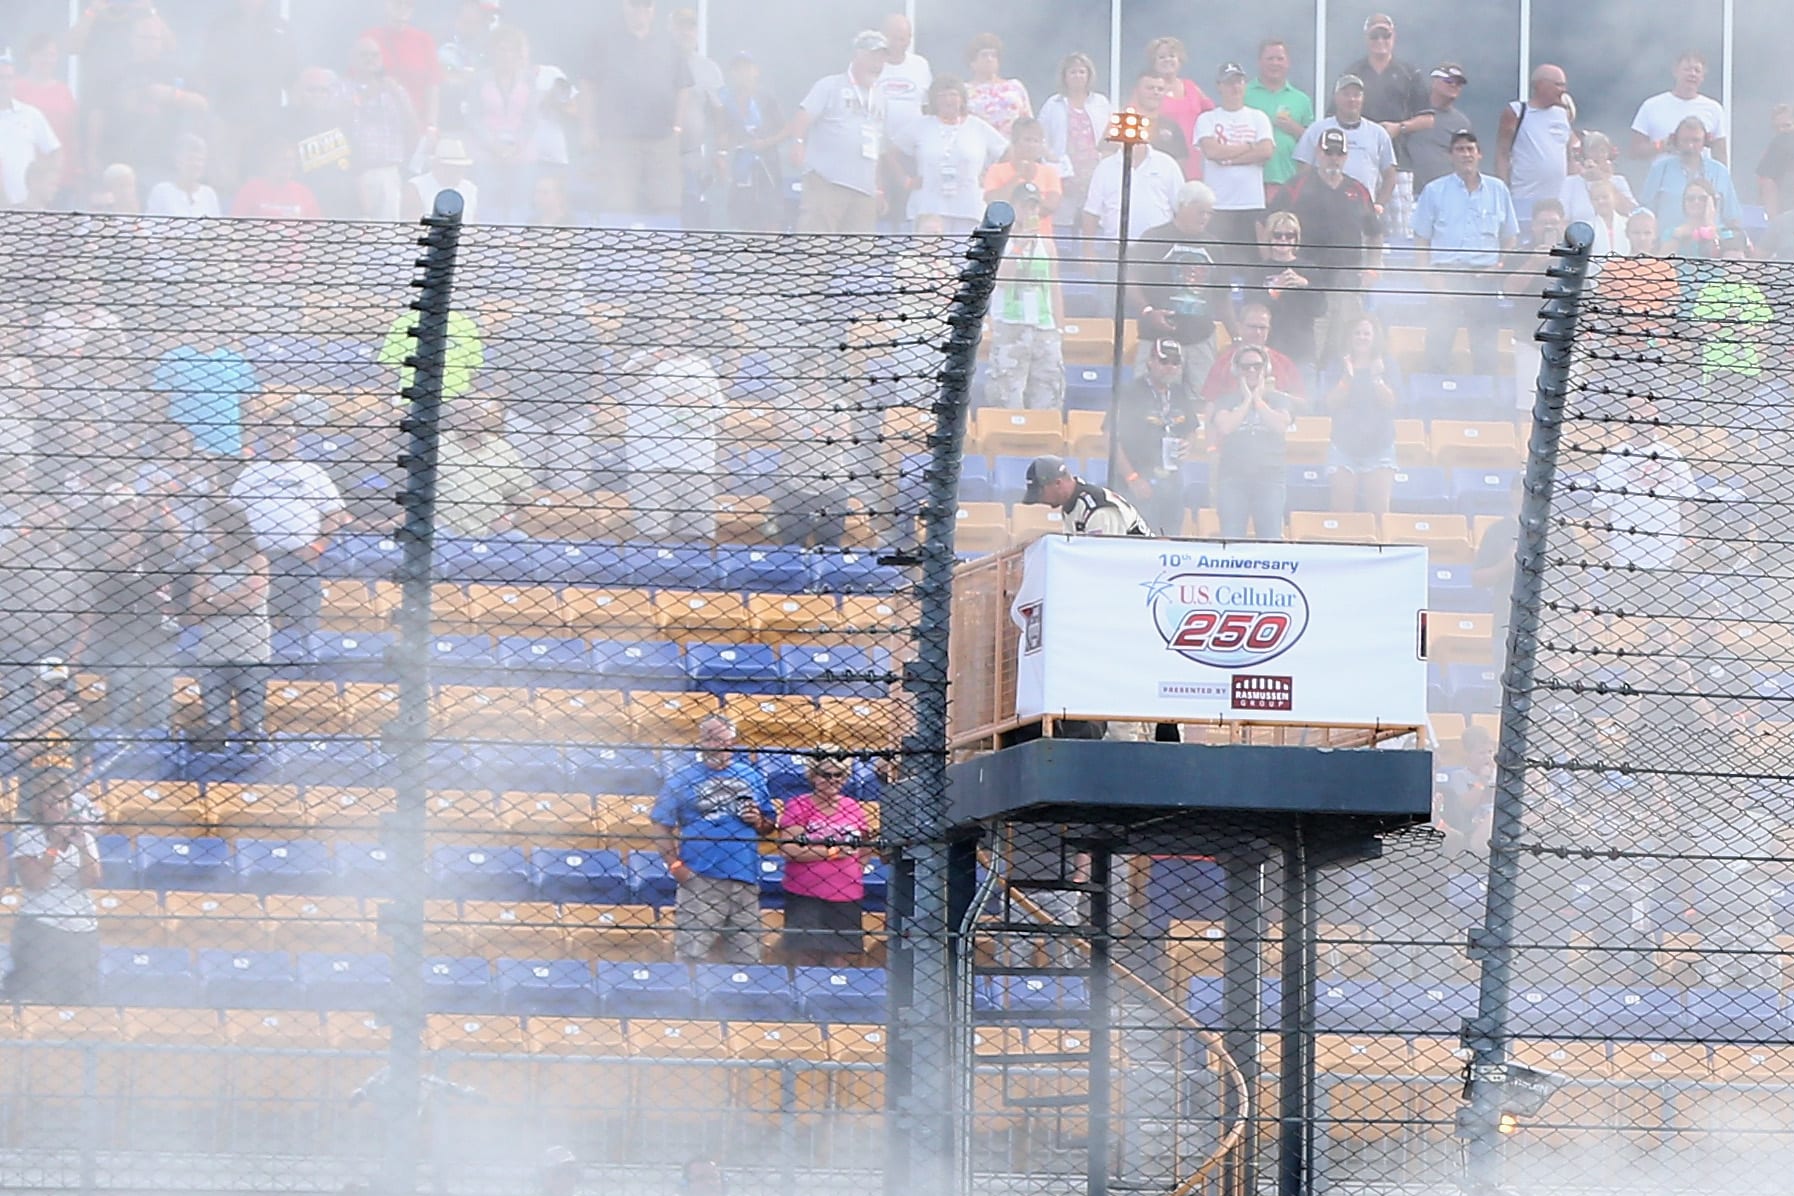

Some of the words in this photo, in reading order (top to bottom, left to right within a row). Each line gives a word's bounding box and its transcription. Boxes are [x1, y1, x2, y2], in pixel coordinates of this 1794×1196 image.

[1197, 554, 1300, 573] Anniversary
[1180, 585, 1212, 604] U.S.
[1215, 585, 1297, 607] Cellular
[1170, 611, 1290, 651] 250
[1163, 686, 1213, 695] PRESENTED
[1215, 687, 1227, 695] BY
[1235, 691, 1289, 700] RASMUSSEN
[1240, 700, 1285, 708] GROUP
